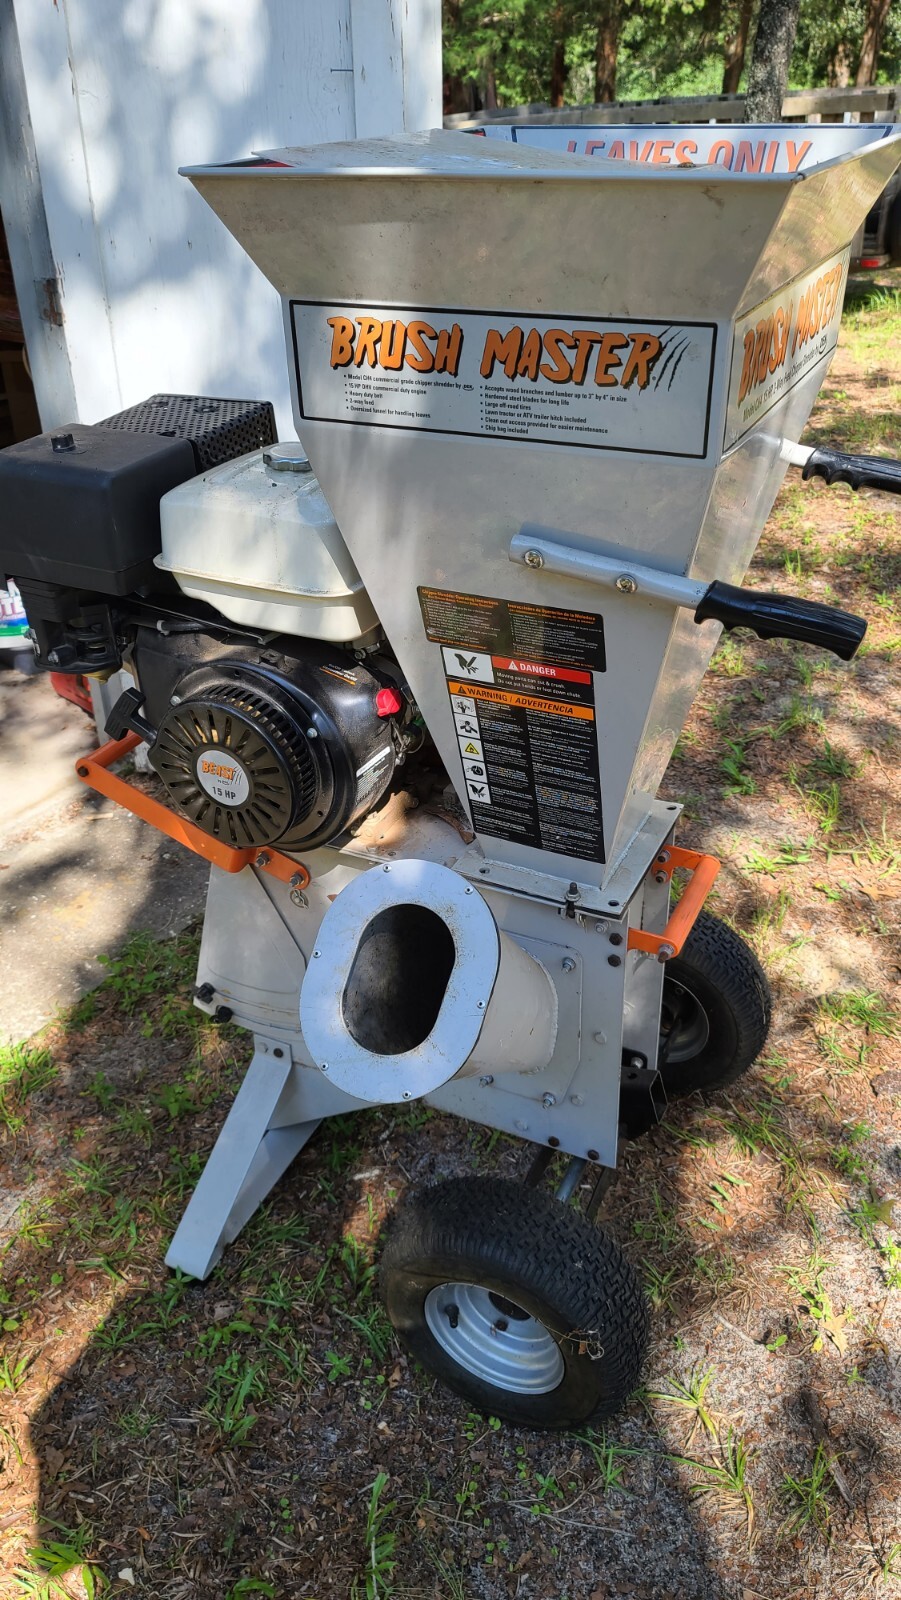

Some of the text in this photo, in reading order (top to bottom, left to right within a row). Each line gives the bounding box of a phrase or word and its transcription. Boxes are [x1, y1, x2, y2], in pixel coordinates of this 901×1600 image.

[327, 316, 662, 393] BRUSH MASTER
[737, 299, 794, 409] BRUSH
[415, 379, 433, 387] chipper
[455, 382, 461, 390] by
[484, 385, 505, 393] Accepts
[520, 663, 556, 677] DANGER
[466, 687, 508, 702] WARNING
[514, 697, 574, 715] ADVERTENCIA
[201, 759, 236, 781] BEAST
[212, 786, 237, 800] 15 HP
